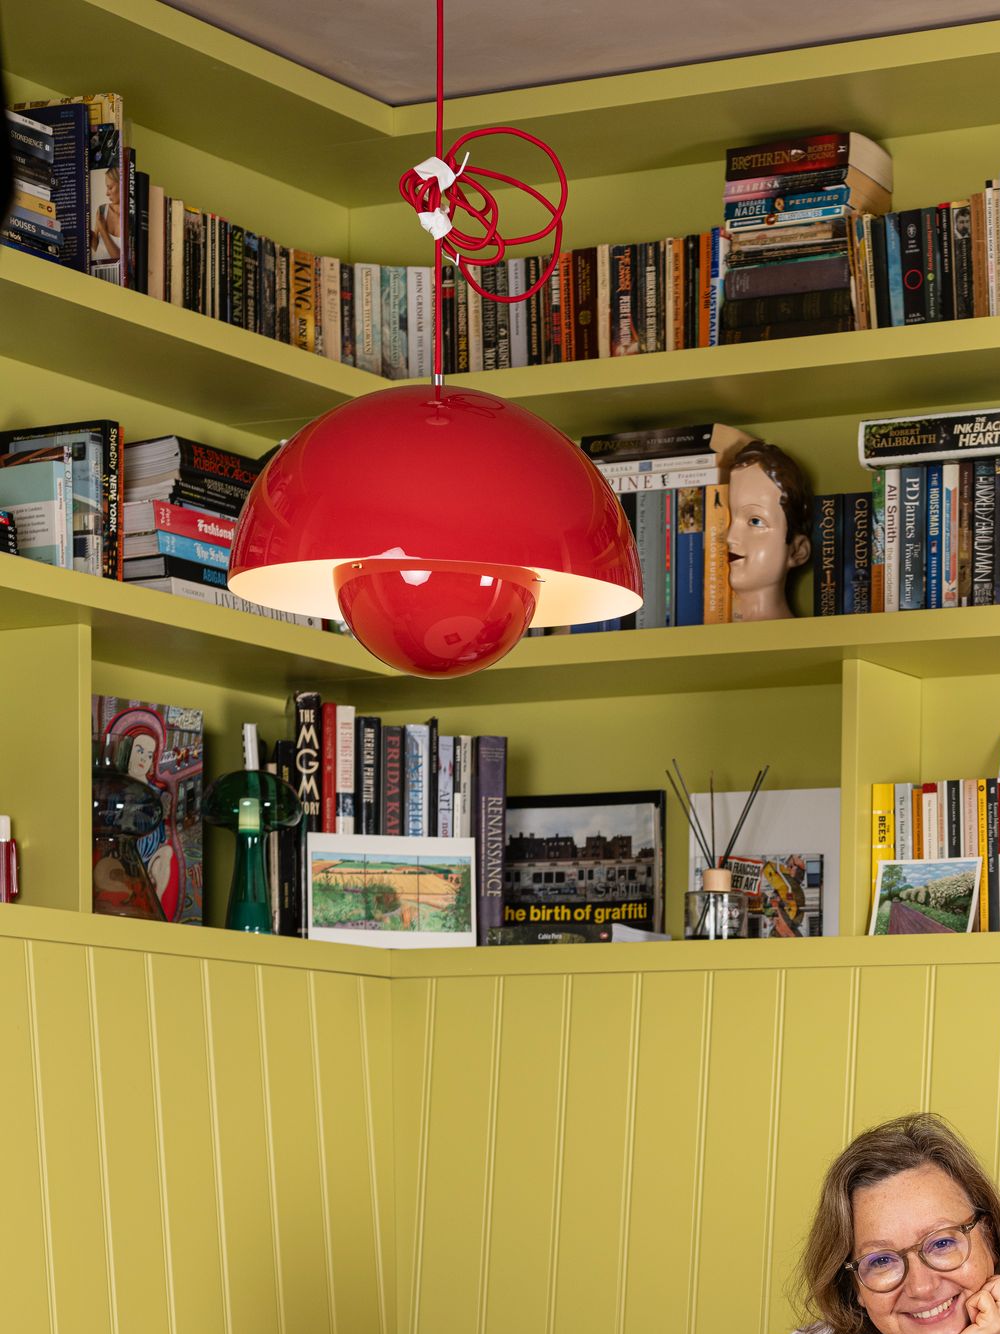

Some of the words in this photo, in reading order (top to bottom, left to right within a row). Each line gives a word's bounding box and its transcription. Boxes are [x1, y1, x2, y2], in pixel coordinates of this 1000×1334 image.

[734, 205, 768, 218] NADEL
[788, 194, 839, 206] PETRIFIED
[9, 217, 36, 233] HOUSES
[295, 259, 312, 313] KING
[710, 284, 718, 346] AUSTRALIA
[873, 433, 937, 449] GALBRAITH
[953, 423, 973, 435] INK
[110, 428, 118, 471] StyleCity
[110, 474, 118, 501] NEW
[886, 484, 898, 501] Ali
[110, 502, 118, 533] YORK
[886, 505, 898, 544] Smith
[905, 501, 920, 539] James
[904, 543, 914, 572] Private
[904, 574, 914, 602] Patient
[298, 709, 315, 724] THE
[364, 728, 374, 765] AMERICAN
[296, 724, 320, 801] MGM
[387, 736, 400, 797] FRIDA
[364, 767, 374, 804] PRIMITIVE
[878, 815, 886, 844] BEES
[486, 796, 502, 897] RENAISSANCE
[732, 863, 762, 879] FRANCISCO
[504, 906, 526, 922] he
[530, 905, 572, 921] birth
[574, 904, 592, 920] of
[594, 902, 648, 924] graffiti
